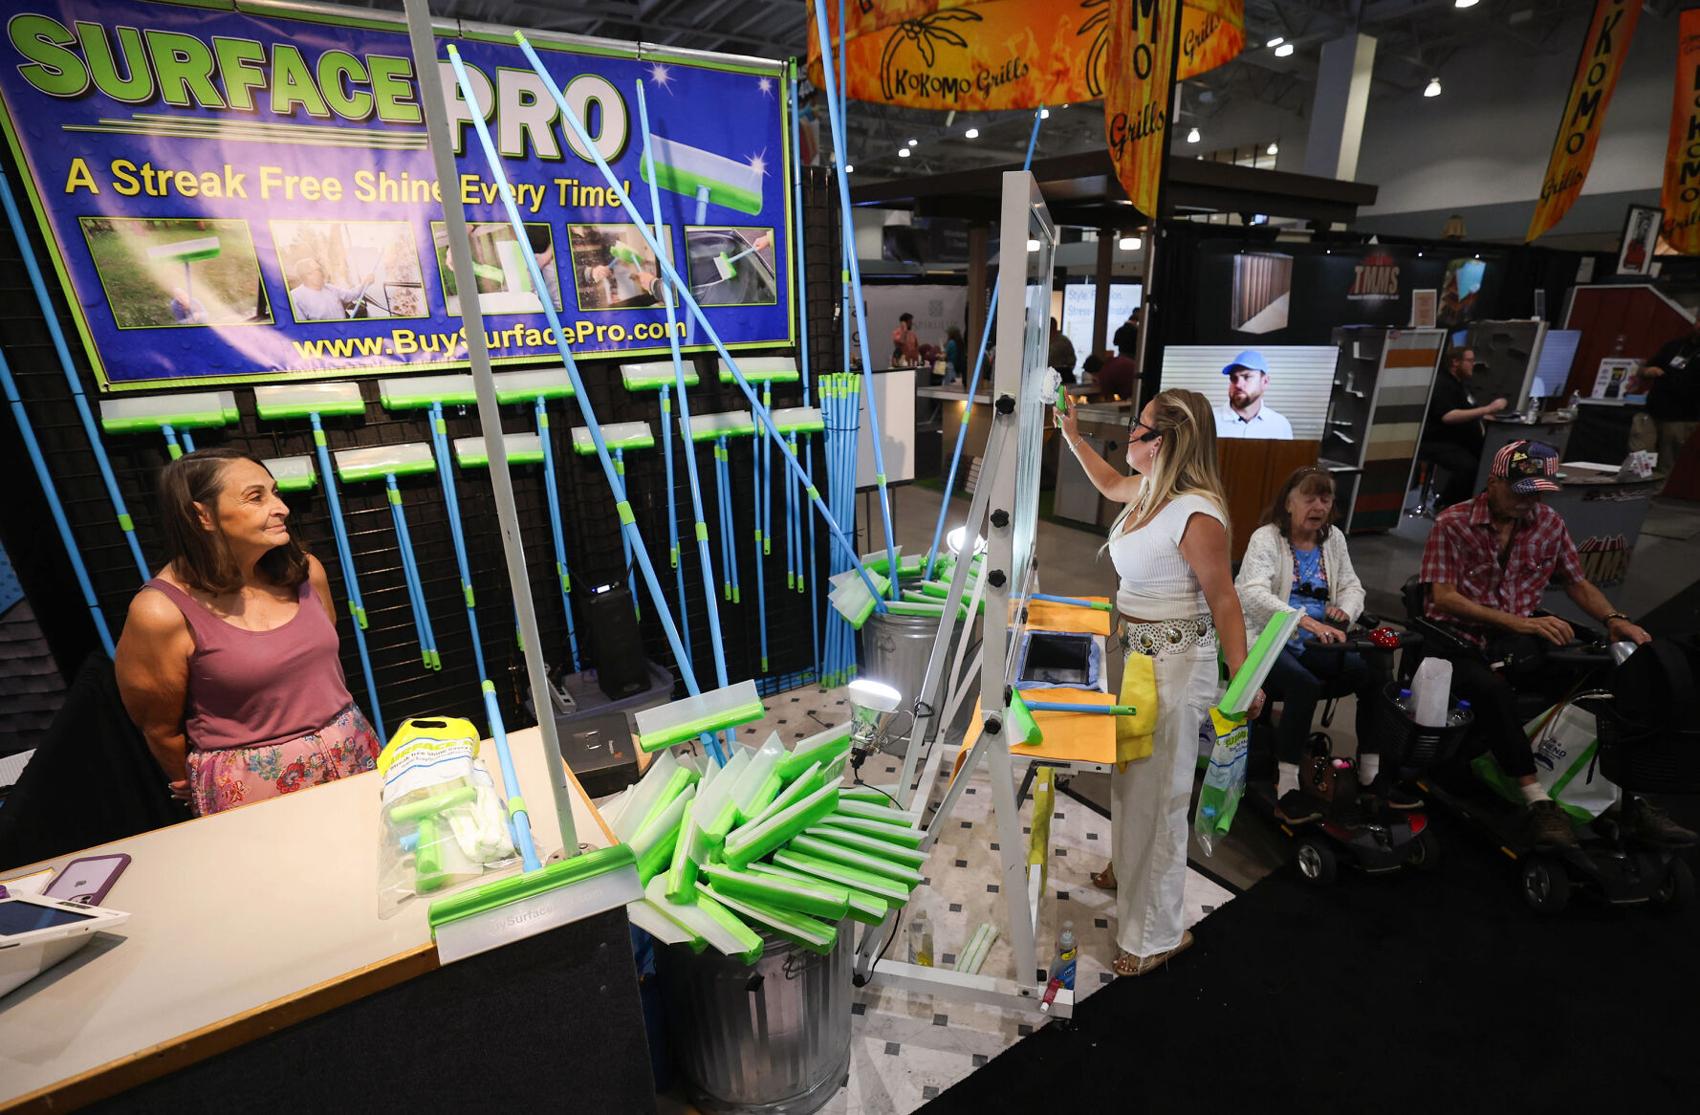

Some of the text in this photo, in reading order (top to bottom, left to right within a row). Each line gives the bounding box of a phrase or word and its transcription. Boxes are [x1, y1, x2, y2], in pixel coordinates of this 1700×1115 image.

[1184, 13, 1221, 66] Grills
[7, 12, 630, 165] SURFACE PRO
[895, 57, 1029, 104] KOKOMO Grills
[1566, 0, 1624, 155] KOMO
[1110, 101, 1165, 162] Grills
[65, 157, 99, 194] A
[112, 158, 246, 199] Streak
[259, 166, 343, 201] Free
[354, 170, 443, 204] Shine
[554, 178, 630, 208] Time!
[1541, 166, 1583, 203] Grills
